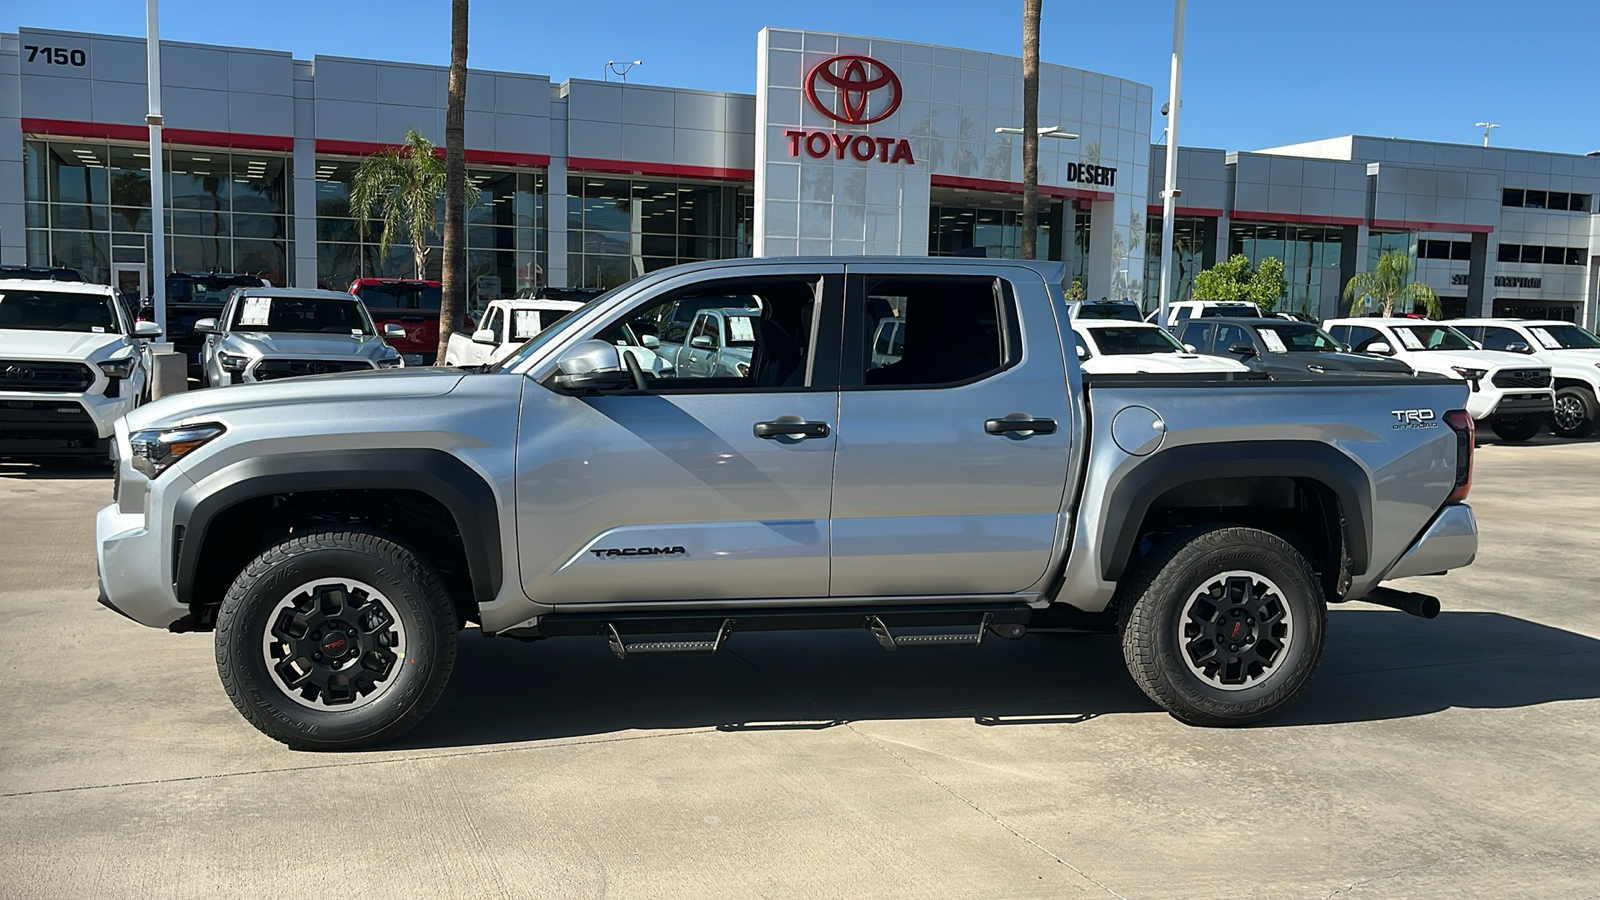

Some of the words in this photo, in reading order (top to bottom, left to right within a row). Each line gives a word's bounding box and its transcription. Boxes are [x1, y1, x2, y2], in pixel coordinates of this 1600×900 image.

[25, 45, 86, 66] 7150
[785, 130, 915, 164] TOYOTA
[1067, 162, 1117, 186] DESERT
[1391, 409, 1435, 423] TRD
[590, 546, 686, 557] TACOMA
[325, 640, 345, 649] TRD
